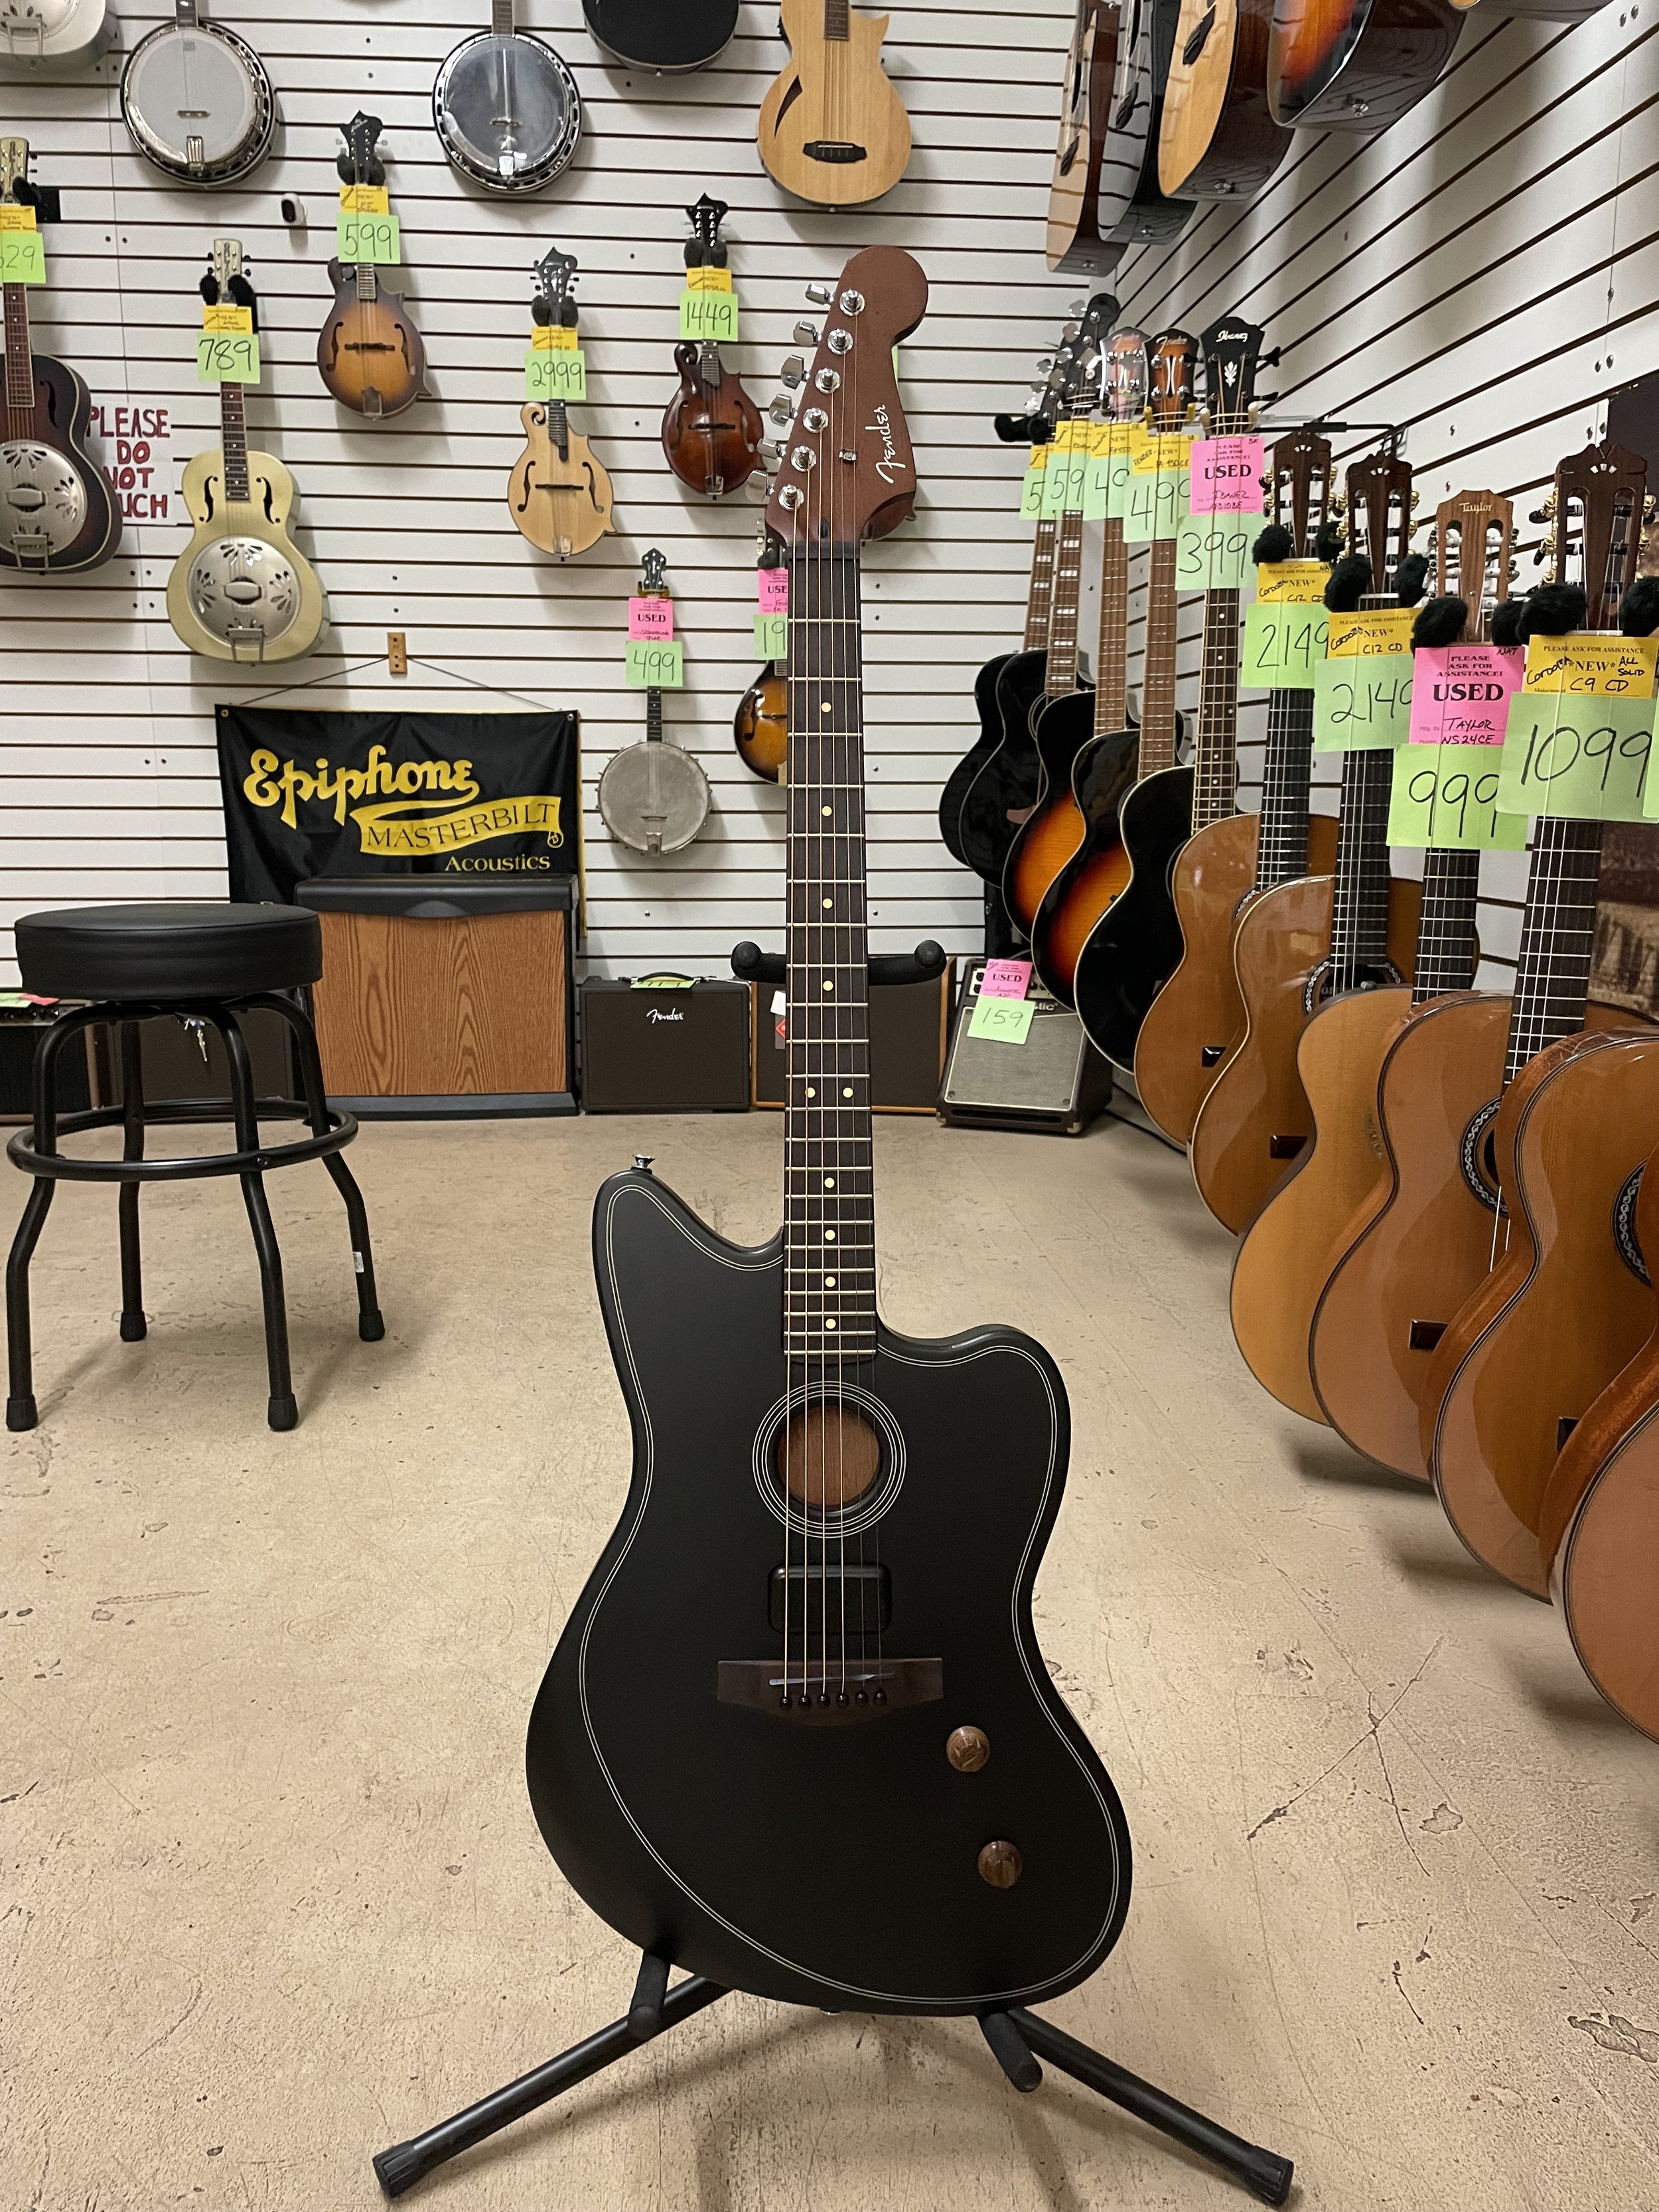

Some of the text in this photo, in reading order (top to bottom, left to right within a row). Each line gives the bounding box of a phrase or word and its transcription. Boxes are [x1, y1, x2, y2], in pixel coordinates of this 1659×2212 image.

[344, 223, 392, 260] 599
[687, 301, 731, 335] 1449
[1155, 334, 1188, 354] Fender
[1215, 330, 1249, 342] Ibanez
[198, 338, 252, 372] 789
[532, 360, 582, 390] 2999
[86, 406, 171, 439] PLEASE
[117, 439, 151, 465] DO
[865, 404, 906, 484] Fender
[103, 466, 155, 490] NOT
[1204, 465, 1252, 480] USED
[1212, 490, 1250, 499] IBANEZ
[116, 492, 168, 519] UCH
[1459, 502, 1492, 514] Taylor
[1178, 532, 1249, 578] 399
[768, 585, 788, 594] USE
[638, 613, 666, 623] USED
[1256, 621, 1329, 669] 2149
[1362, 642, 1403, 654] C12 CD
[1496, 647, 1518, 656] NAT
[634, 649, 675, 682] 499
[1619, 656, 1638, 667] ALL
[1617, 668, 1645, 676] SOLID
[1433, 683, 1504, 701] USED
[1569, 678, 1629, 692] C9 CD
[1443, 717, 1496, 732] TAYLOR
[1520, 723, 1653, 798] 1099
[243, 744, 480, 830] Epiphone
[1408, 770, 1500, 838] 999
[366, 802, 556, 849] MASTERBILT
[445, 855, 551, 873] Acoustics
[992, 973, 1022, 982] USED
[646, 1007, 684, 1024] Fender
[982, 1007, 1023, 1028] 159
